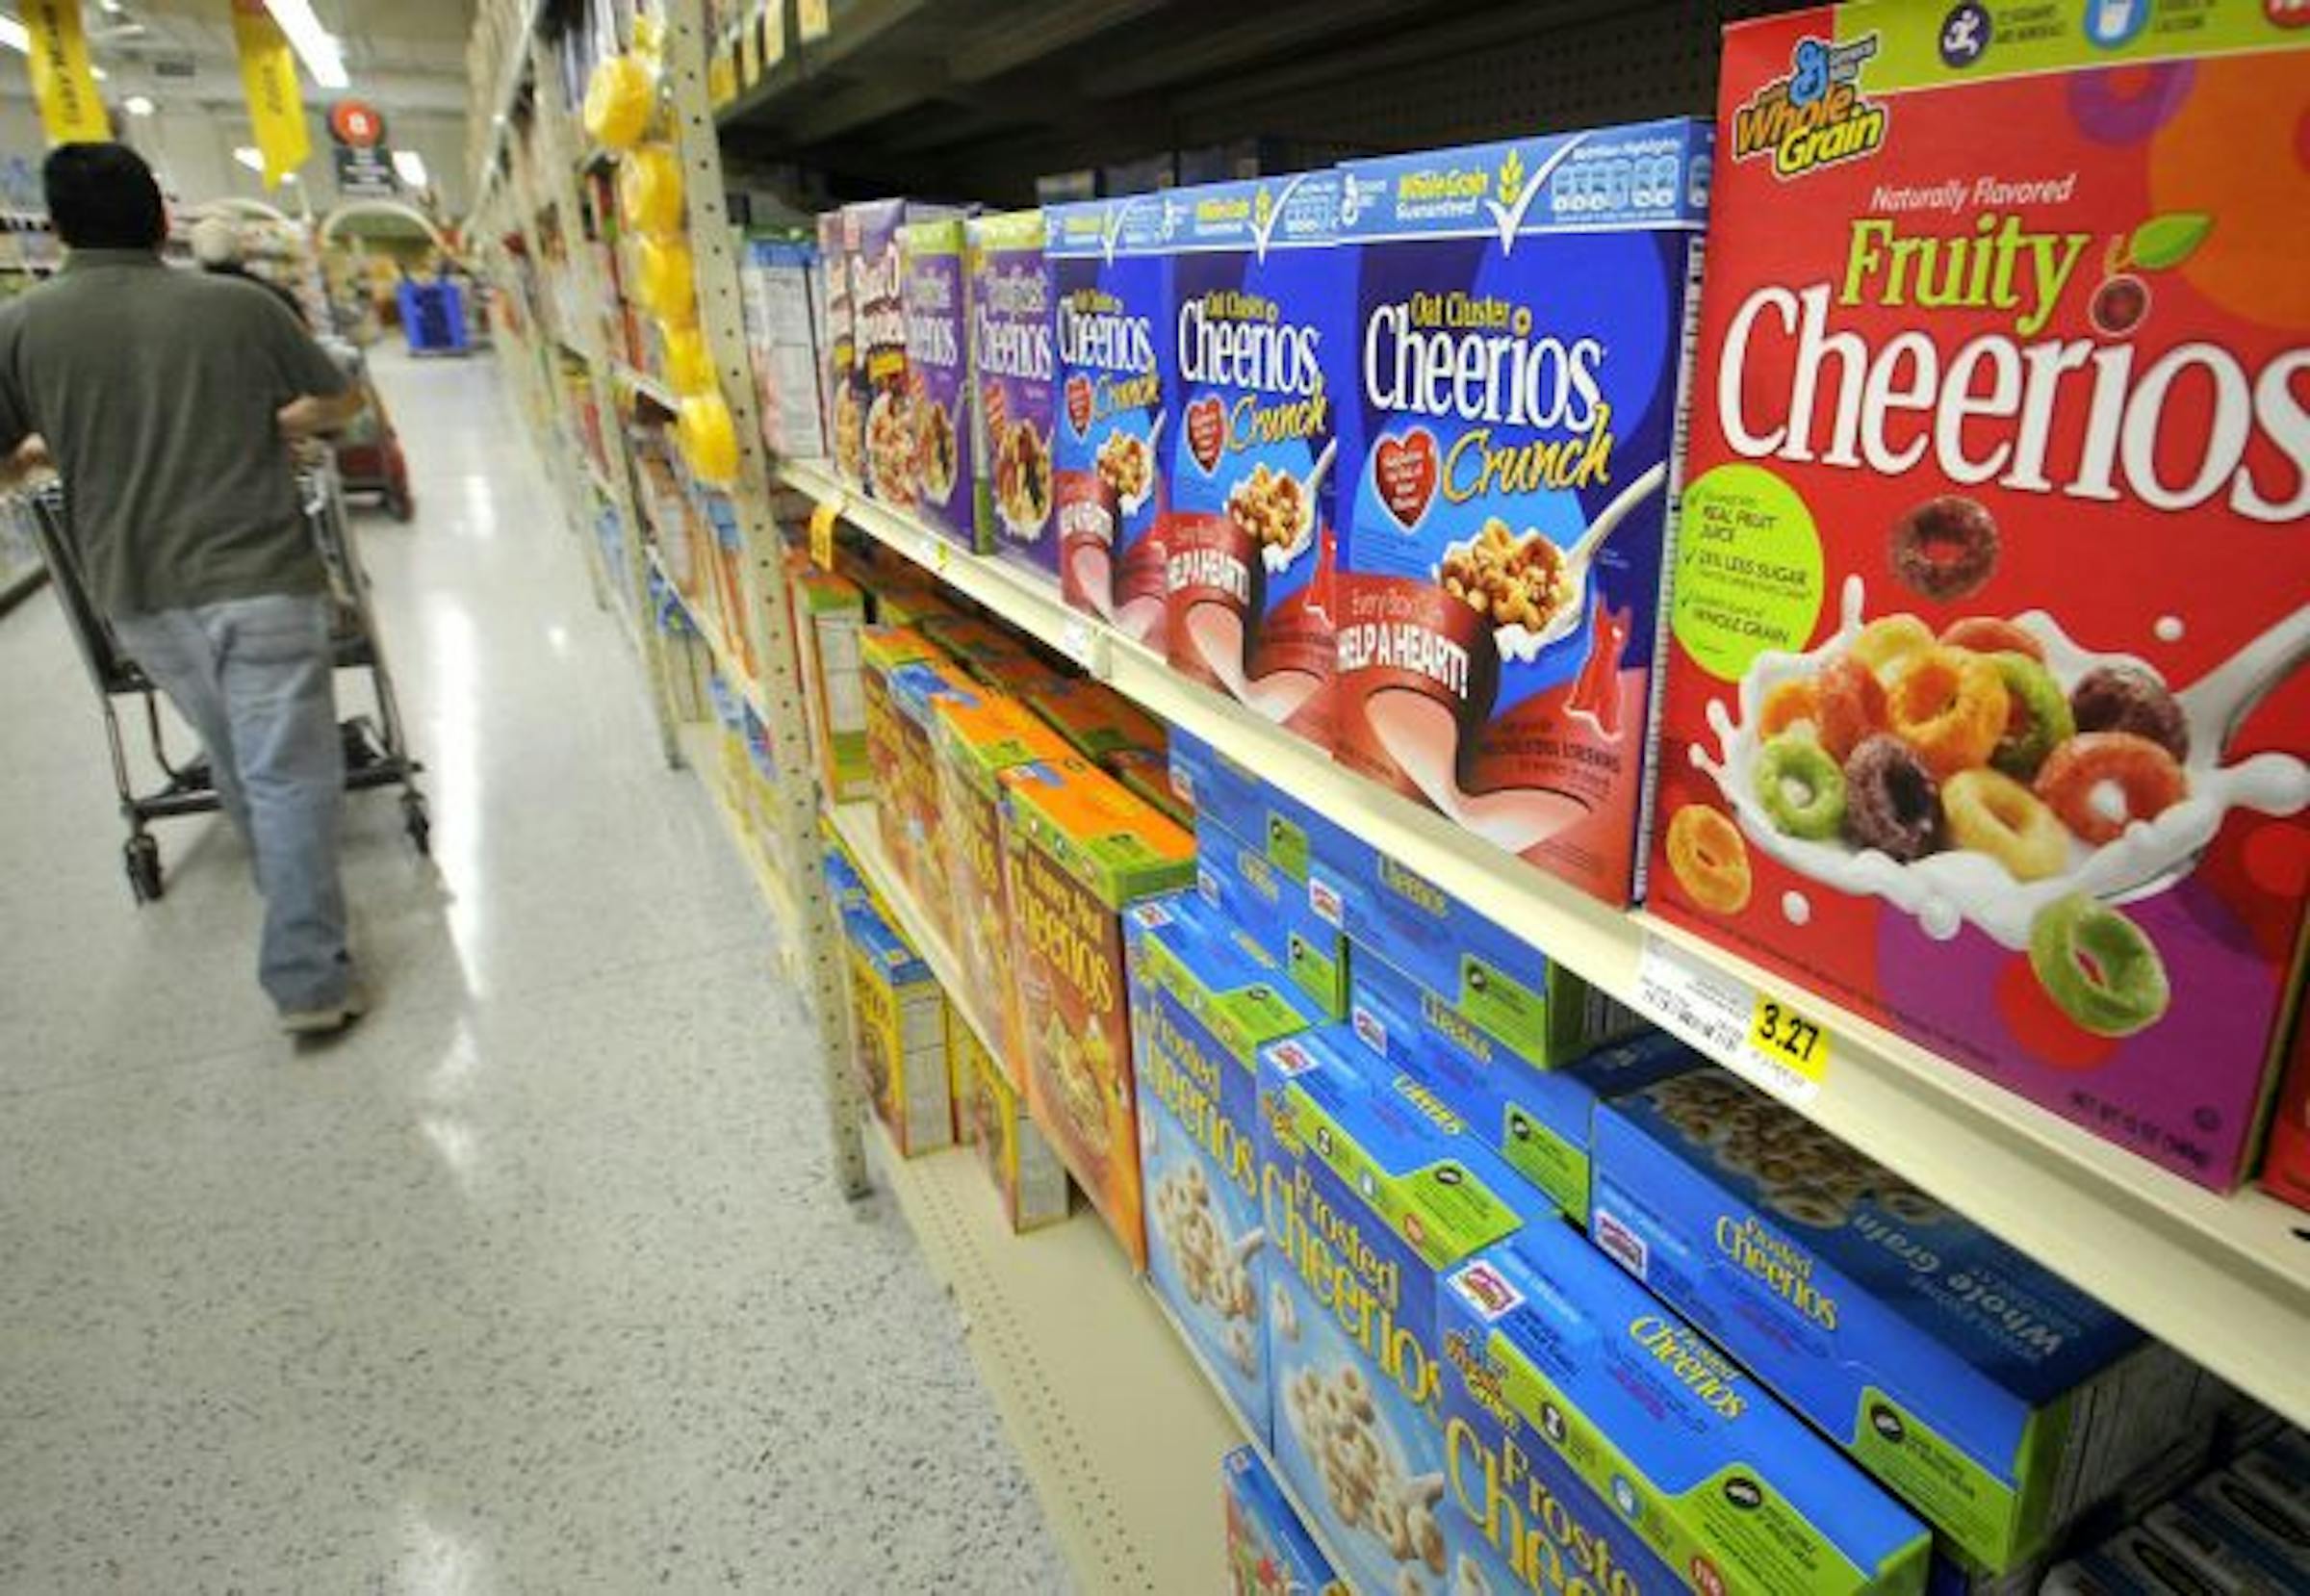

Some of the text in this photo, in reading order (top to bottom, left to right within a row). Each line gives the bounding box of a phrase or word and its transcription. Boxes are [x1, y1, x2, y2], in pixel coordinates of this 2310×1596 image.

[1736, 81, 1855, 157] Whole
[1778, 103, 1884, 174] Grain
[1872, 172, 2077, 212] Naturally Flavored
[1409, 291, 1511, 329] Oat Cluster
[1837, 212, 2090, 336] Fruity
[1177, 297, 1324, 396] Cheerios
[1365, 301, 1603, 432] Cheerios
[1226, 372, 1327, 453] Crunch
[1717, 281, 2310, 524] Cheerios
[1443, 401, 1616, 502] Crunch
[1757, 561, 1808, 585] SUGAR
[1392, 623, 1469, 700] HEART!
[1758, 1004, 1820, 1063] 3.27
[1715, 1214, 1839, 1332] Cheerios
[1629, 1314, 1749, 1421] Cheerios
